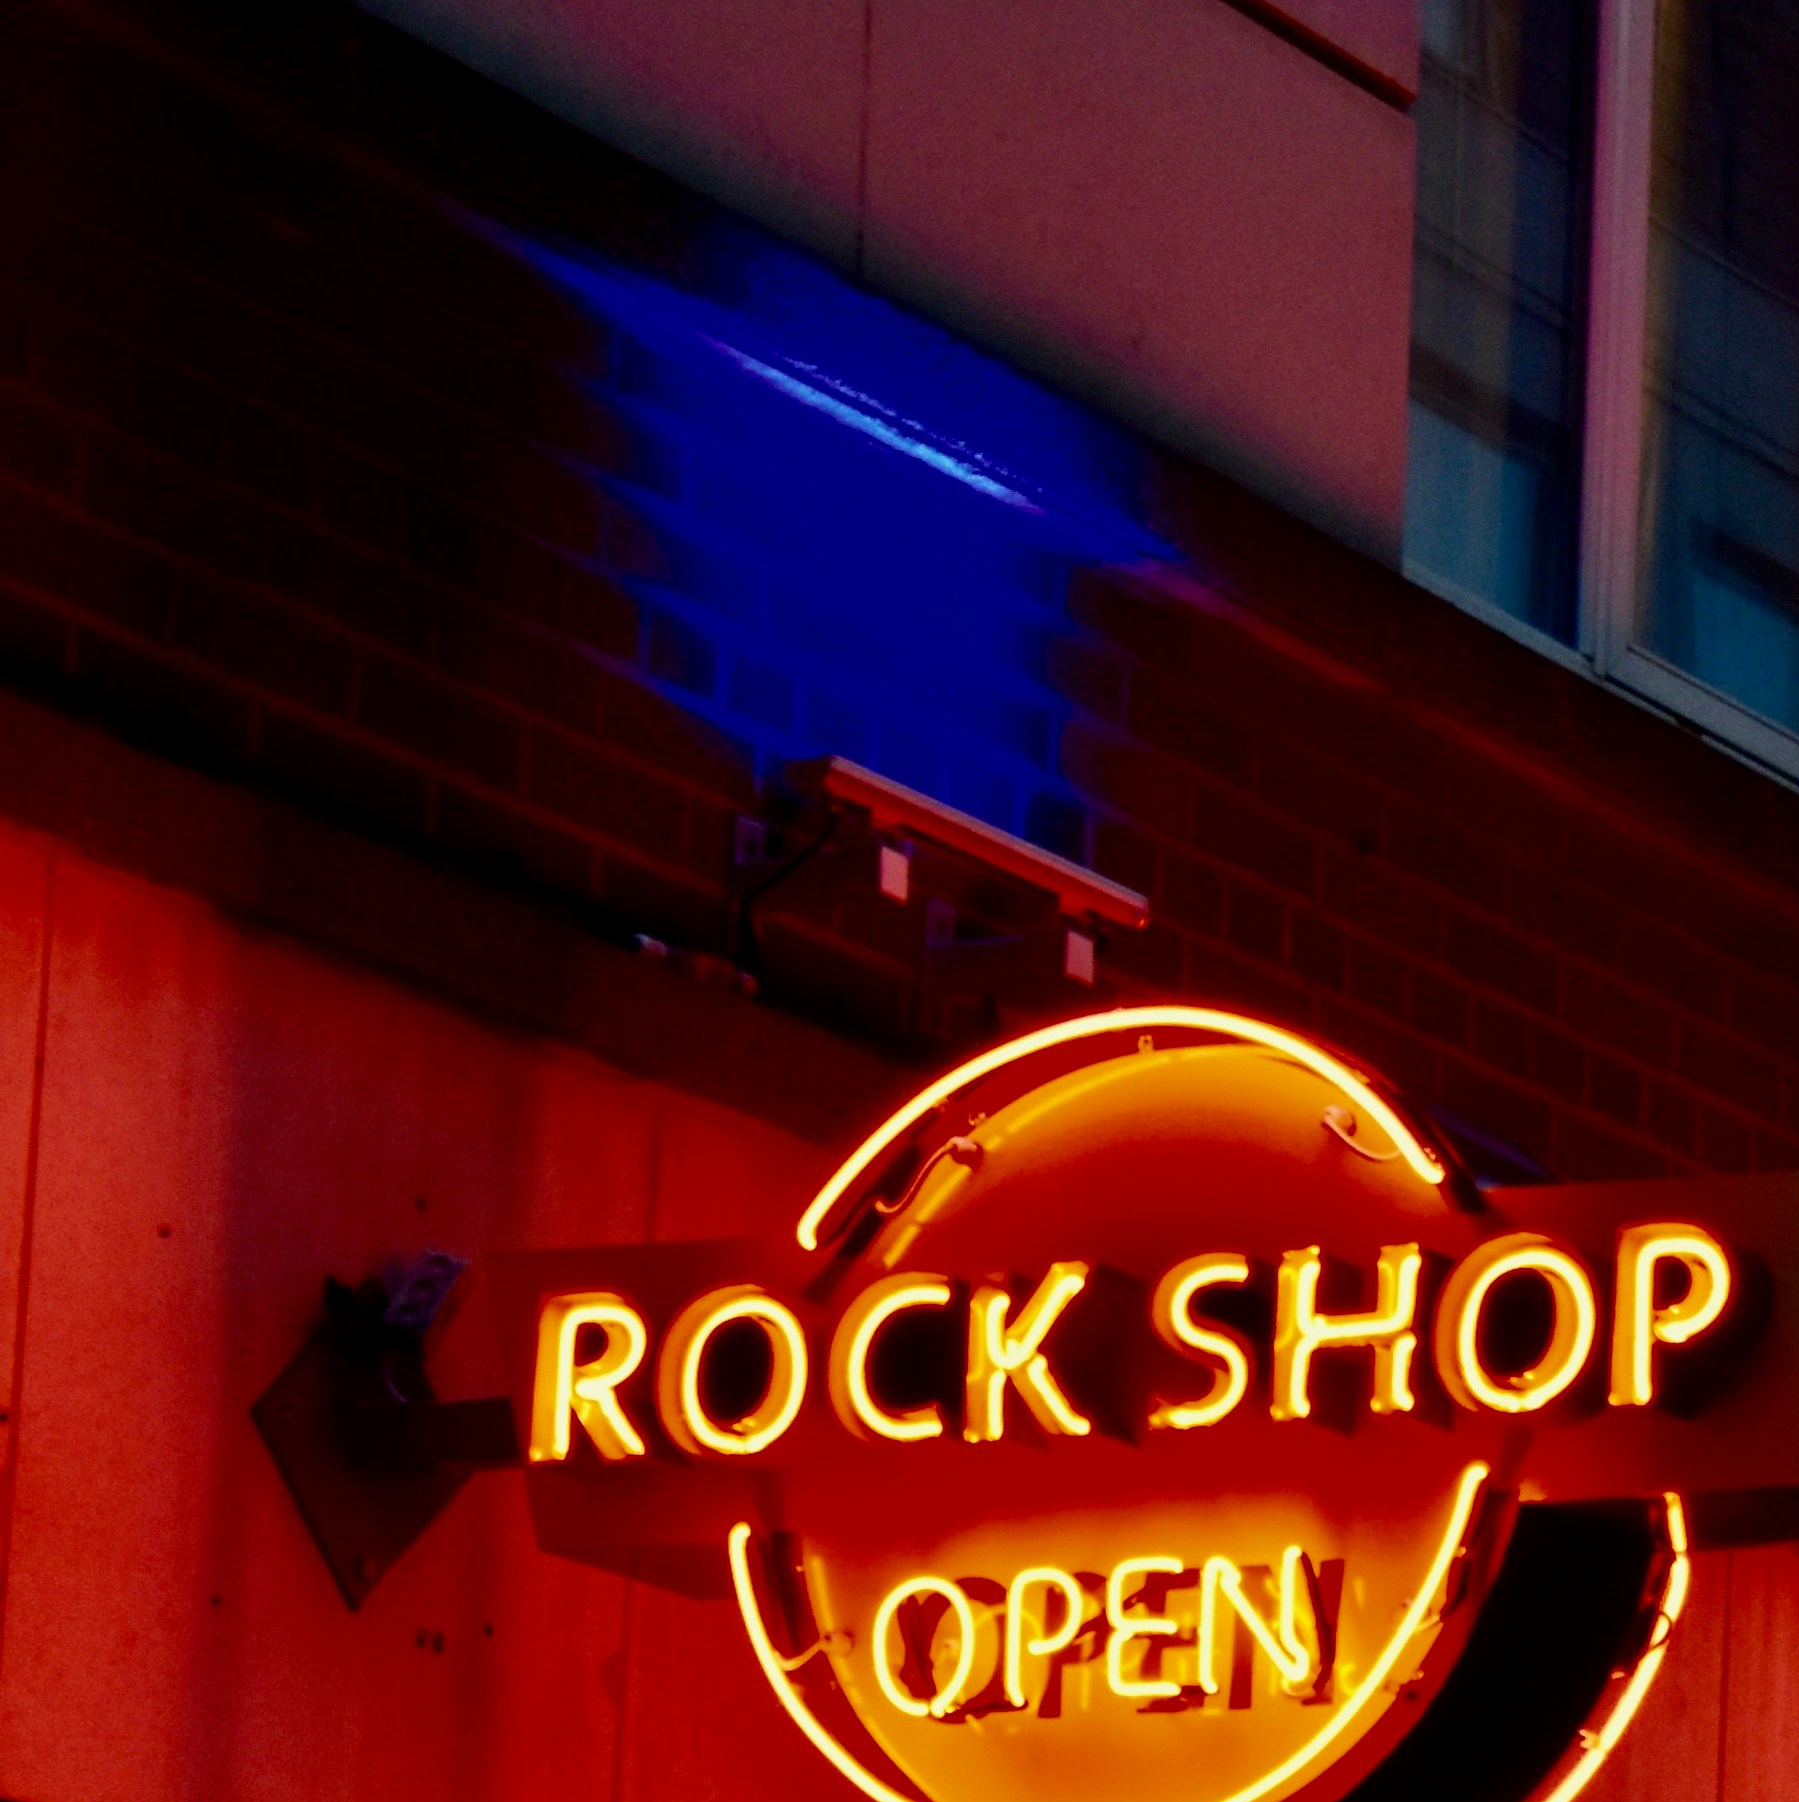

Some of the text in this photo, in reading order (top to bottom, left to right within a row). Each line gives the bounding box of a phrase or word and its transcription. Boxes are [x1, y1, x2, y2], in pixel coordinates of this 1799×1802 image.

[528, 1222, 1733, 1461] ROCK SHOP
[870, 1546, 1315, 1716] OPEN
